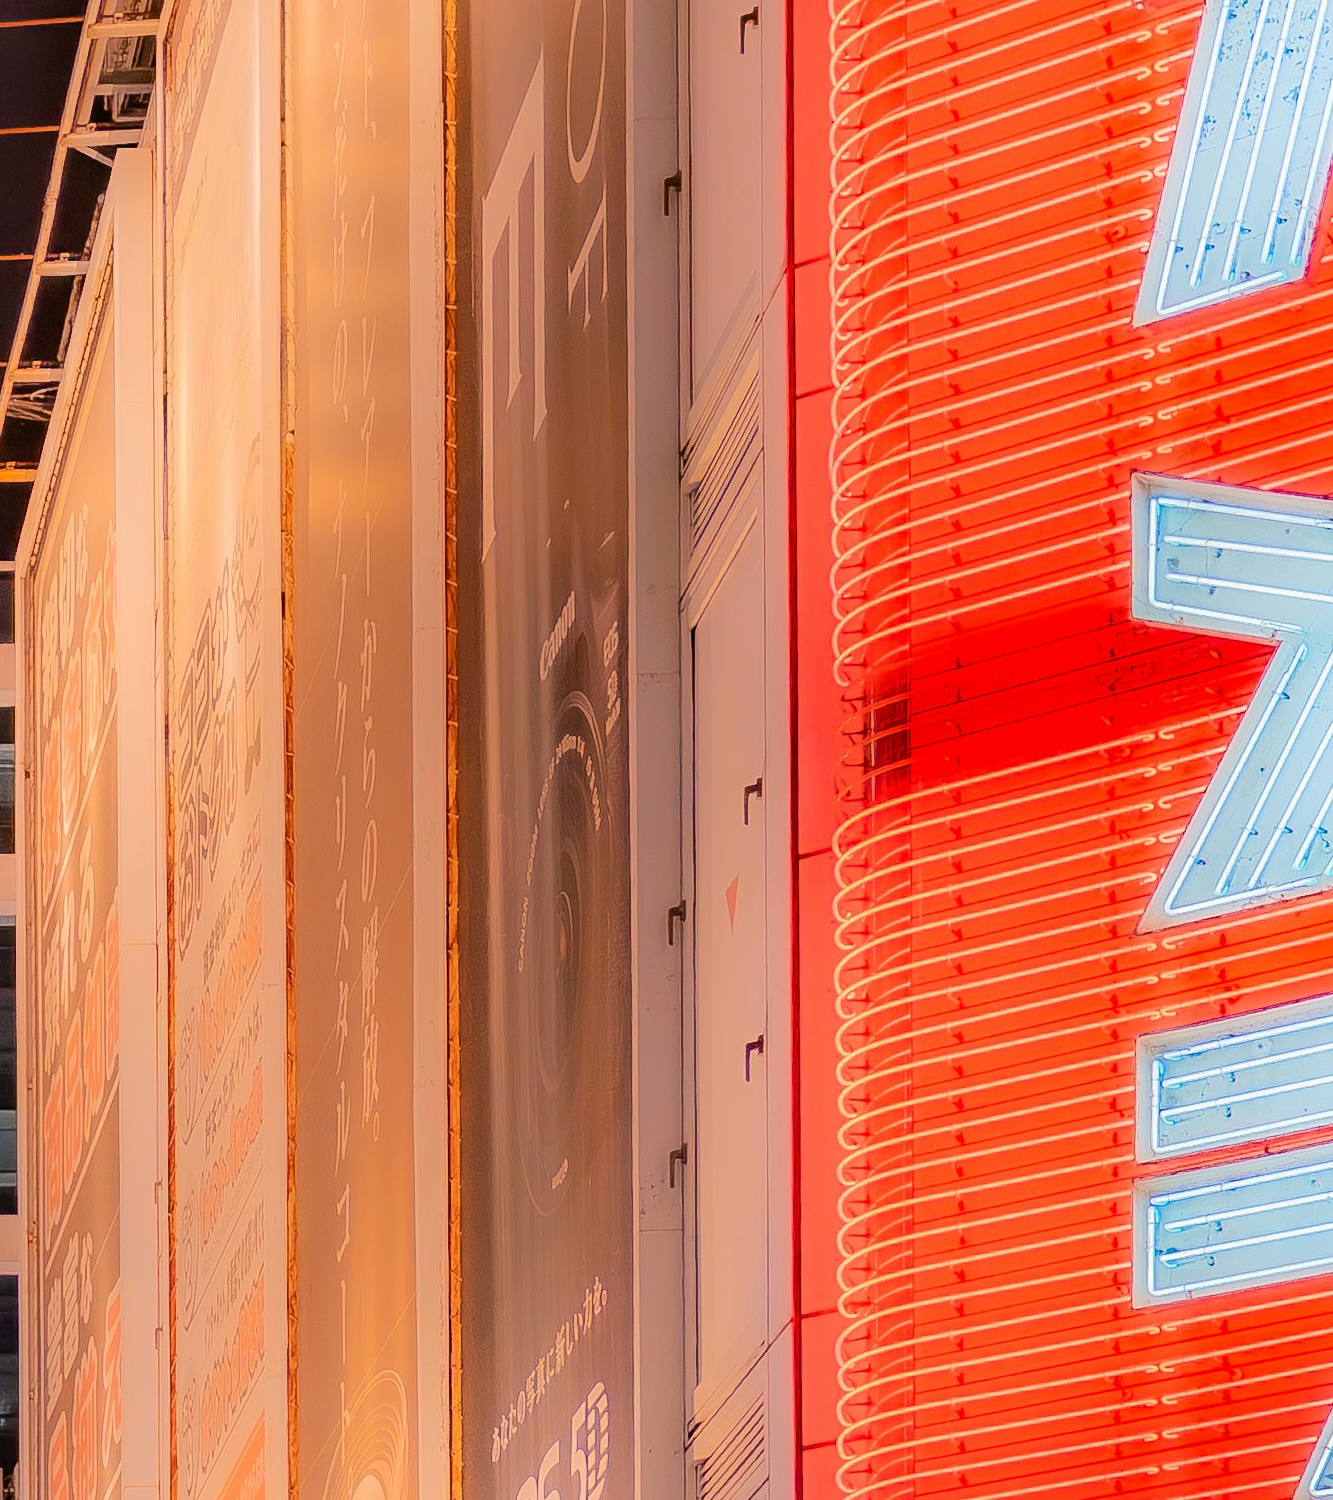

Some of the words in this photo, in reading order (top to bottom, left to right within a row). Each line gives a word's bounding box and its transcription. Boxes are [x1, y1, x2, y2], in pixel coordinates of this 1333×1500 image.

[42, 499, 89, 729] 親切な
[539, 591, 576, 683] Canon
[46, 1230, 94, 1421] 豊富な
[490, 1270, 608, 1465] あなたの写真に新しい力を。
